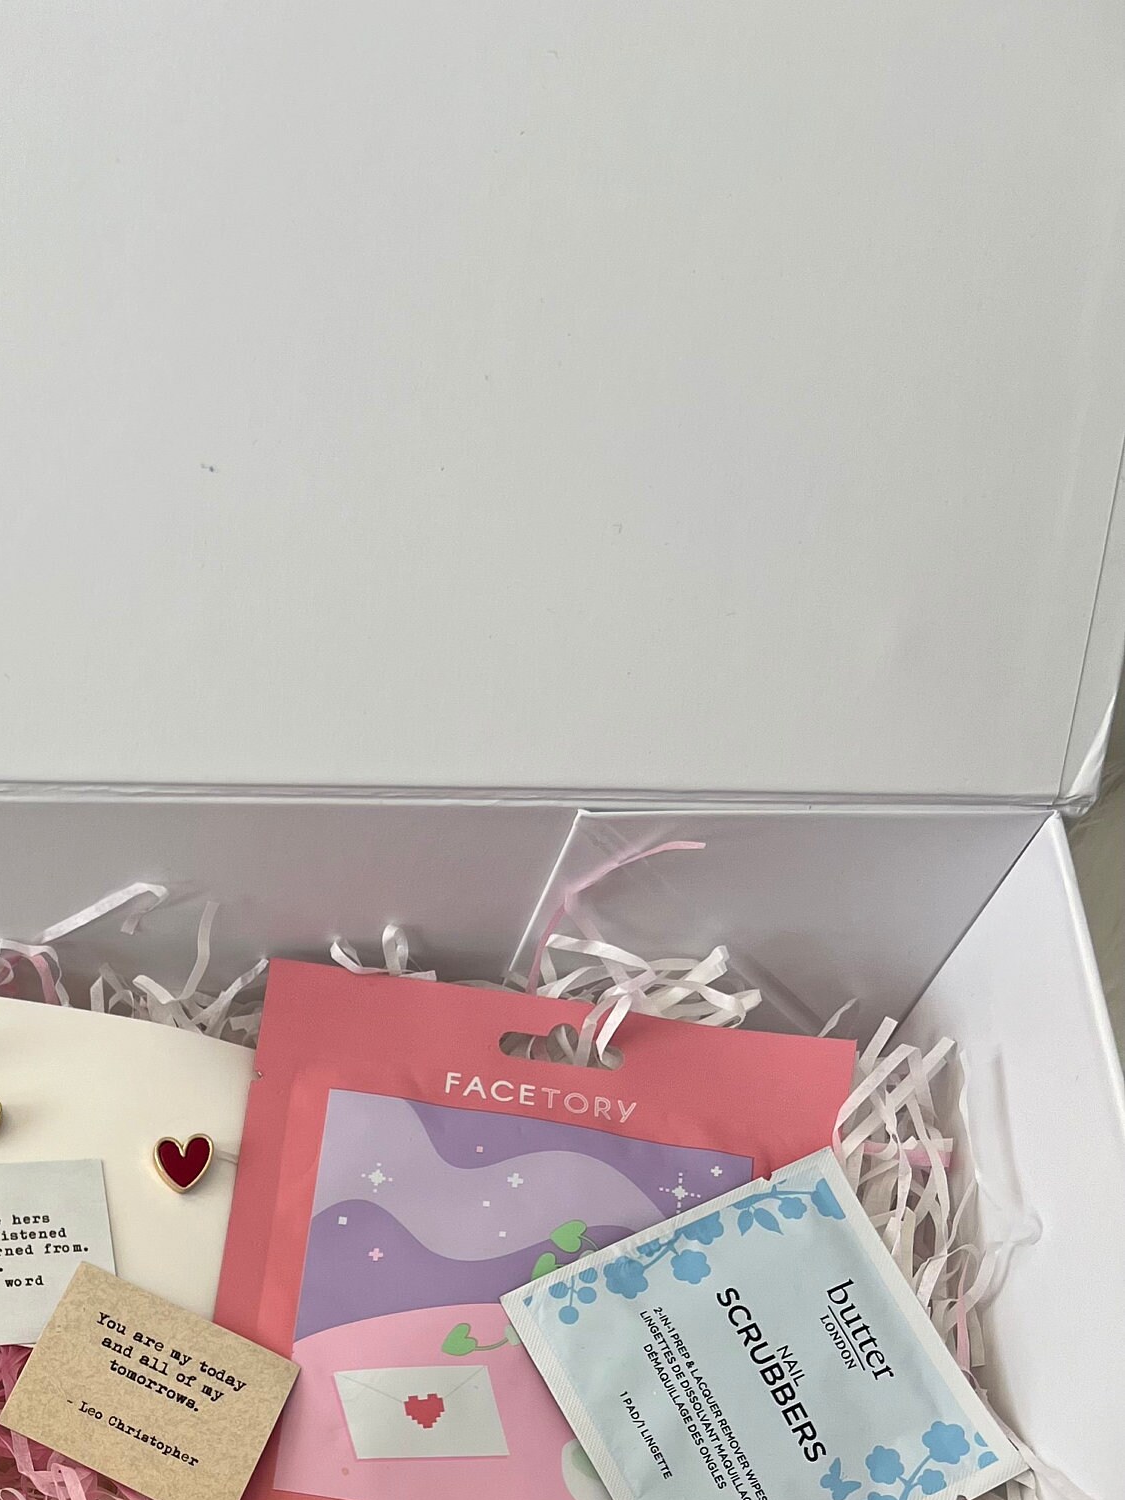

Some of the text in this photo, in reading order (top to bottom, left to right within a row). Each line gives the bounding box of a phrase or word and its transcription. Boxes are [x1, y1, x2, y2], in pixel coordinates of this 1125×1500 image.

[444, 1071, 637, 1123] FACETORY
[12, 1213, 50, 1226] hers
[43, 1241, 90, 1255] from.
[5, 1274, 44, 1288] word
[96, 1311, 247, 1393] You are my today
[819, 1314, 857, 1370] LONDON
[826, 1278, 894, 1381] butter
[101, 1334, 224, 1402] and all of my
[109, 1359, 200, 1413] tomorrows.
[640, 1311, 676, 1365] LINGETTES
[680, 1379, 719, 1443] DISSOLVANT
[653, 1307, 676, 1338] 2-IN-1
[672, 1332, 690, 1361] PREP
[690, 1368, 723, 1419] LACQUER
[717, 1418, 750, 1470] REMOVER
[716, 1288, 827, 1462] SCRUBBERS
[777, 1345, 805, 1387] NAIL
[79, 1400, 199, 1467] Leo Christopher
[640, 1429, 673, 1480] LINGETTE
[688, 1423, 704, 1446] DES
[699, 1447, 727, 1490] ONGLES
